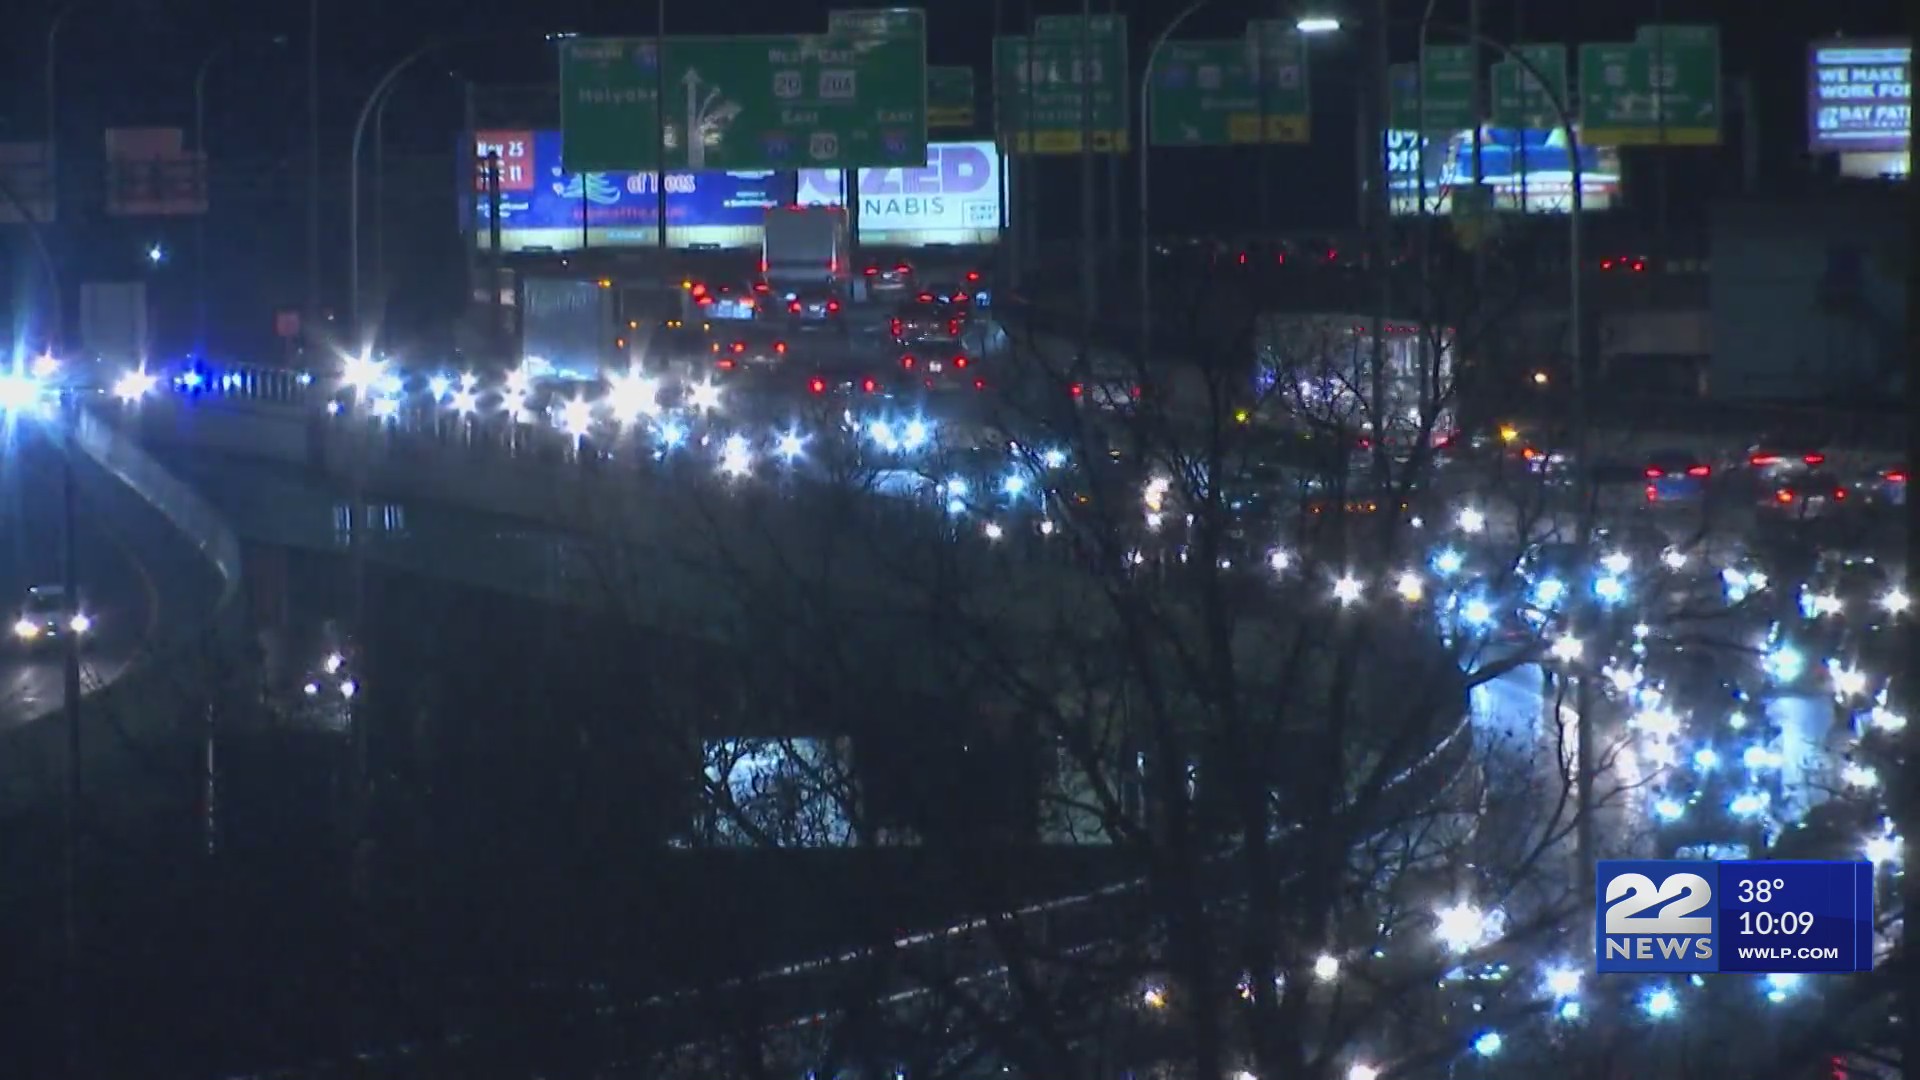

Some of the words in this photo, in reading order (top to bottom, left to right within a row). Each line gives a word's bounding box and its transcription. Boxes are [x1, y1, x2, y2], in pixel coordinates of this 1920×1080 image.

[1819, 68, 1848, 82] WE
[1852, 67, 1904, 82] MAKE
[1820, 84, 1874, 98] WORK
[509, 141, 524, 157] 25
